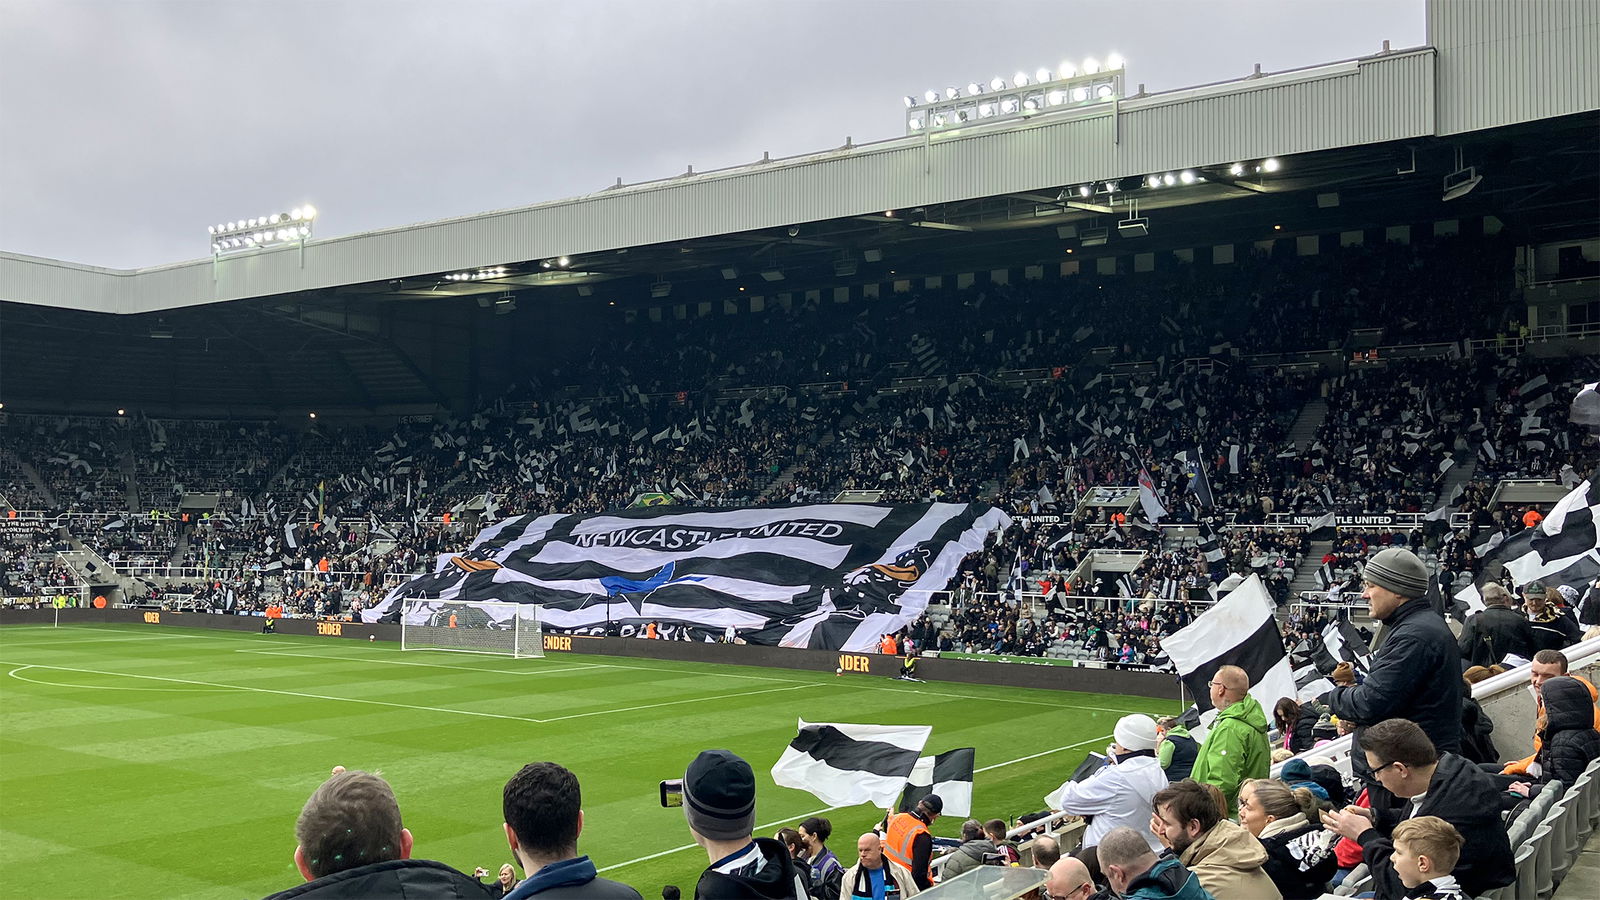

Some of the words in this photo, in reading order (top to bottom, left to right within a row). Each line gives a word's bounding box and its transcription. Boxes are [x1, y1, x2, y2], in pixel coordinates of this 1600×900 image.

[1294, 516, 1353, 524] NEWTLE
[1355, 516, 1391, 524] UNITED
[574, 528, 734, 549] NEWCASTL
[737, 522, 843, 538] NITED
[543, 635, 572, 651] ENDER
[839, 655, 870, 672] NDER
